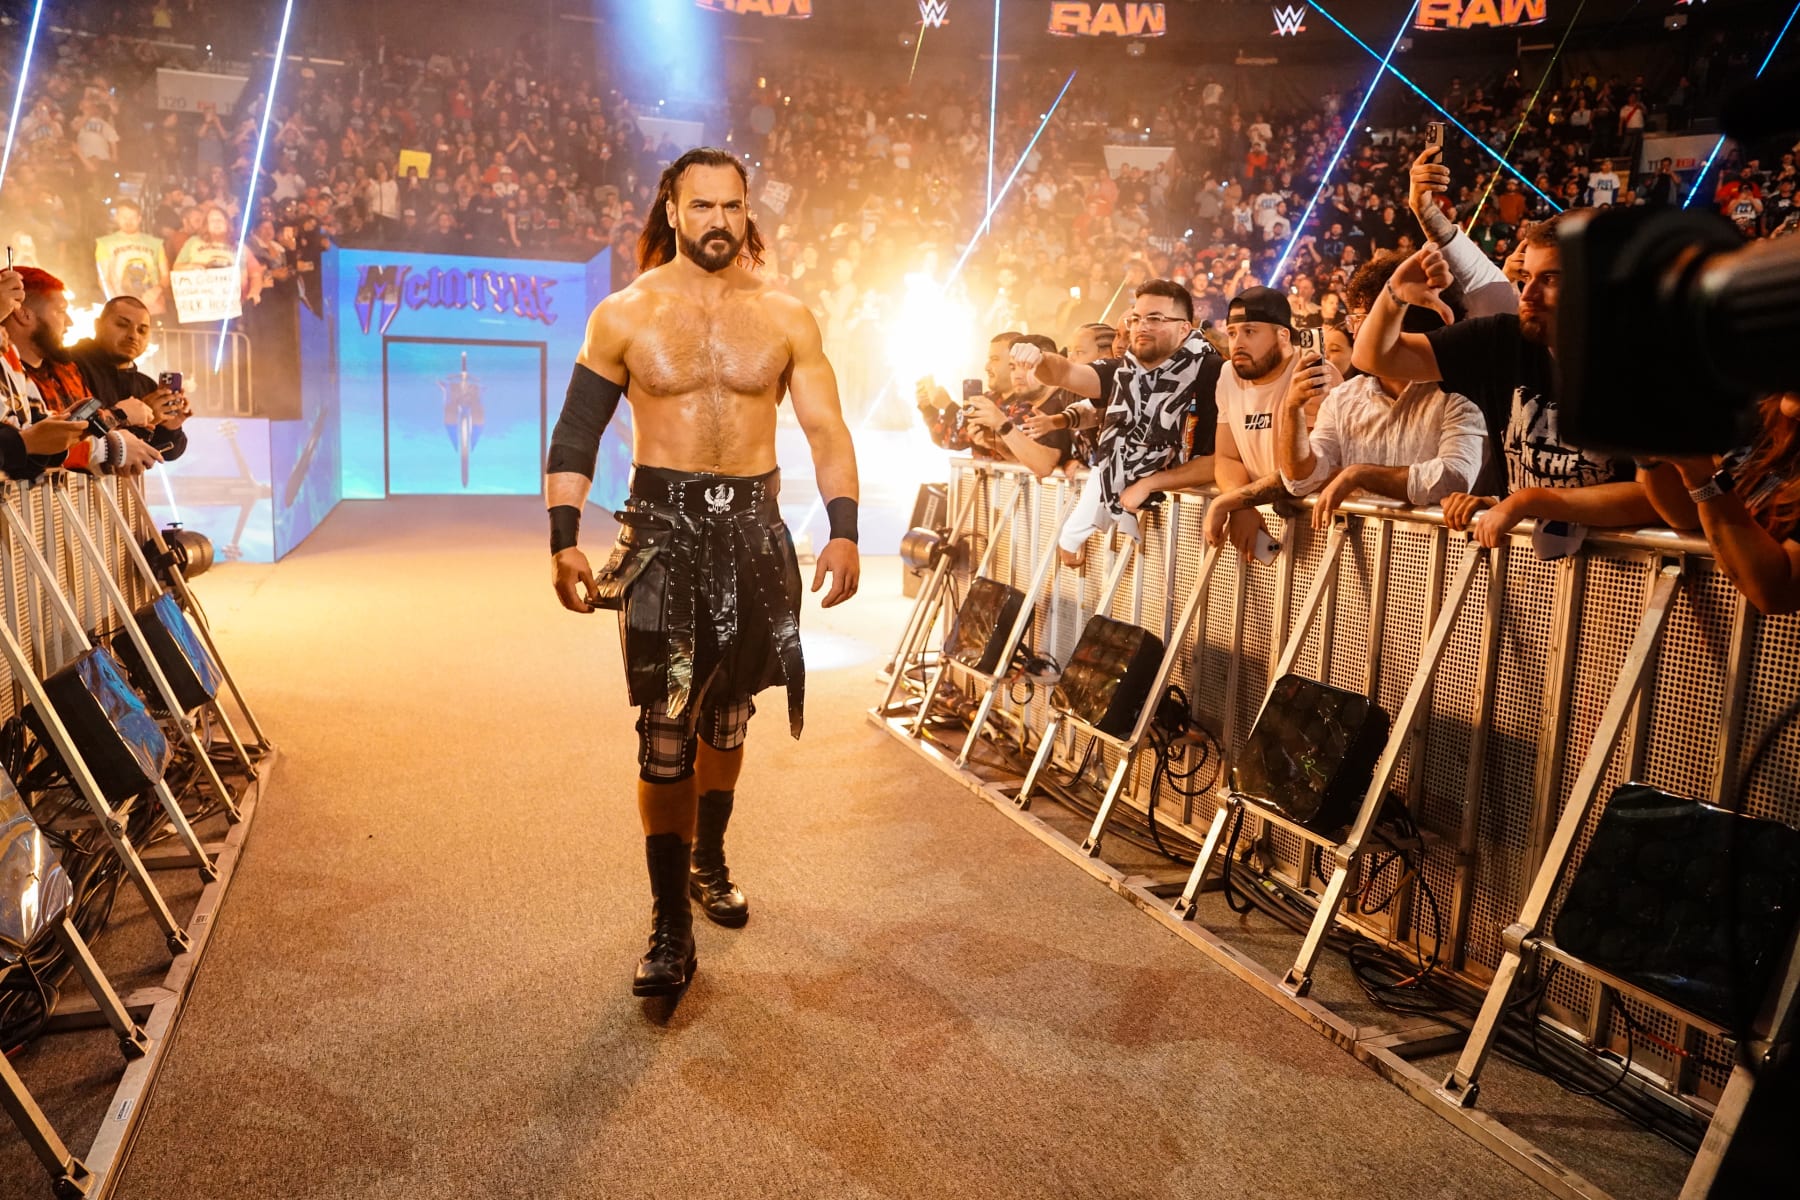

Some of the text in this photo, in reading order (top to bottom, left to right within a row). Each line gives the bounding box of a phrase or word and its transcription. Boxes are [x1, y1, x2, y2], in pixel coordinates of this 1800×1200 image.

[1048, 2, 1167, 36] RAW
[1415, 0, 1547, 29] RAW
[1536, 449, 1580, 476] THE
